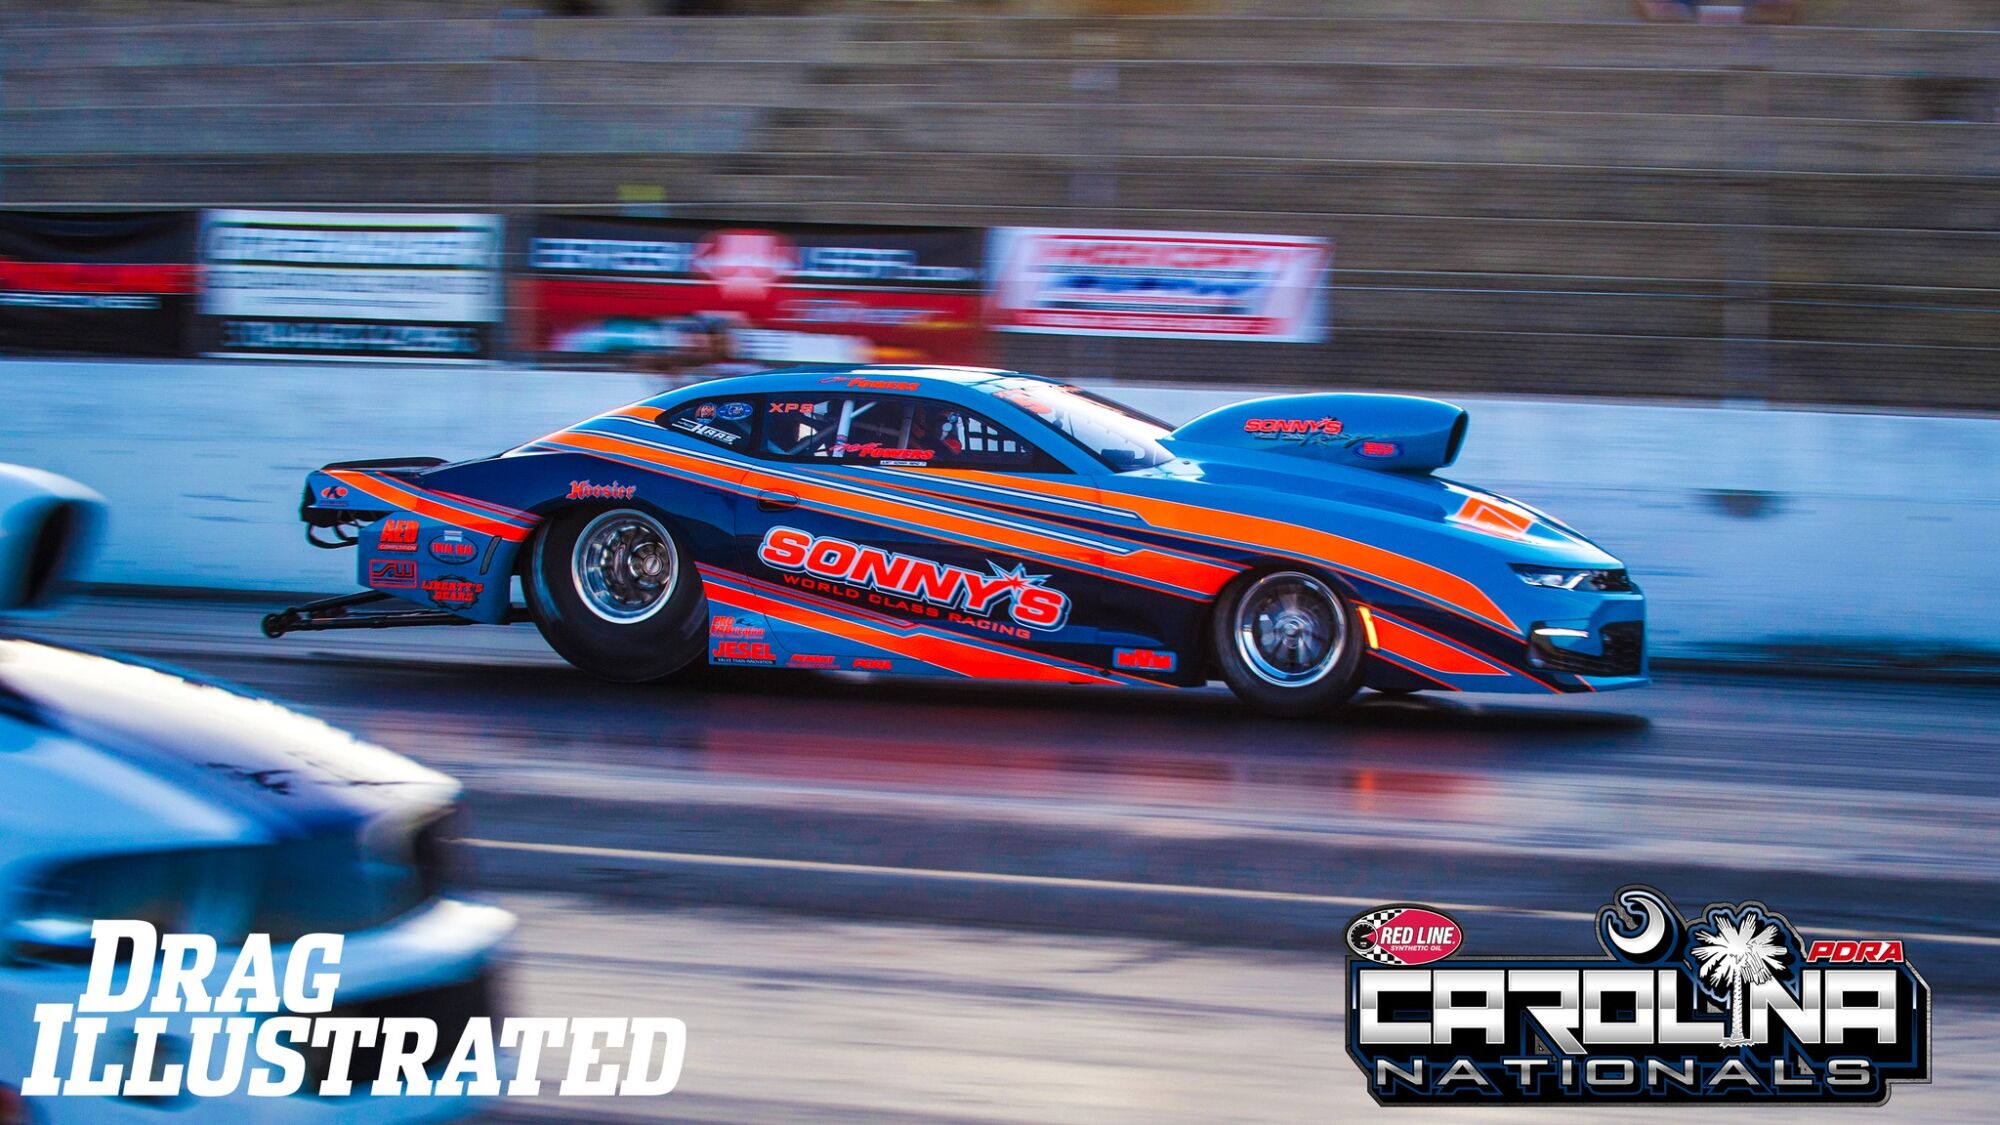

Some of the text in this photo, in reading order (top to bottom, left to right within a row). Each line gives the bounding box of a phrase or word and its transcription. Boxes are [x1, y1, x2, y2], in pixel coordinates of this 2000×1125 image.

[1244, 416, 1343, 434] SONNY'S
[566, 480, 636, 500] Hoosier
[380, 519, 419, 543] AED
[421, 580, 483, 592] LIBERTY'S
[758, 526, 1070, 631] SONNY'S
[433, 591, 474, 602] GEARS
[784, 573, 1032, 640] WORLD CLASS RACING
[712, 641, 777, 660] JESEL
